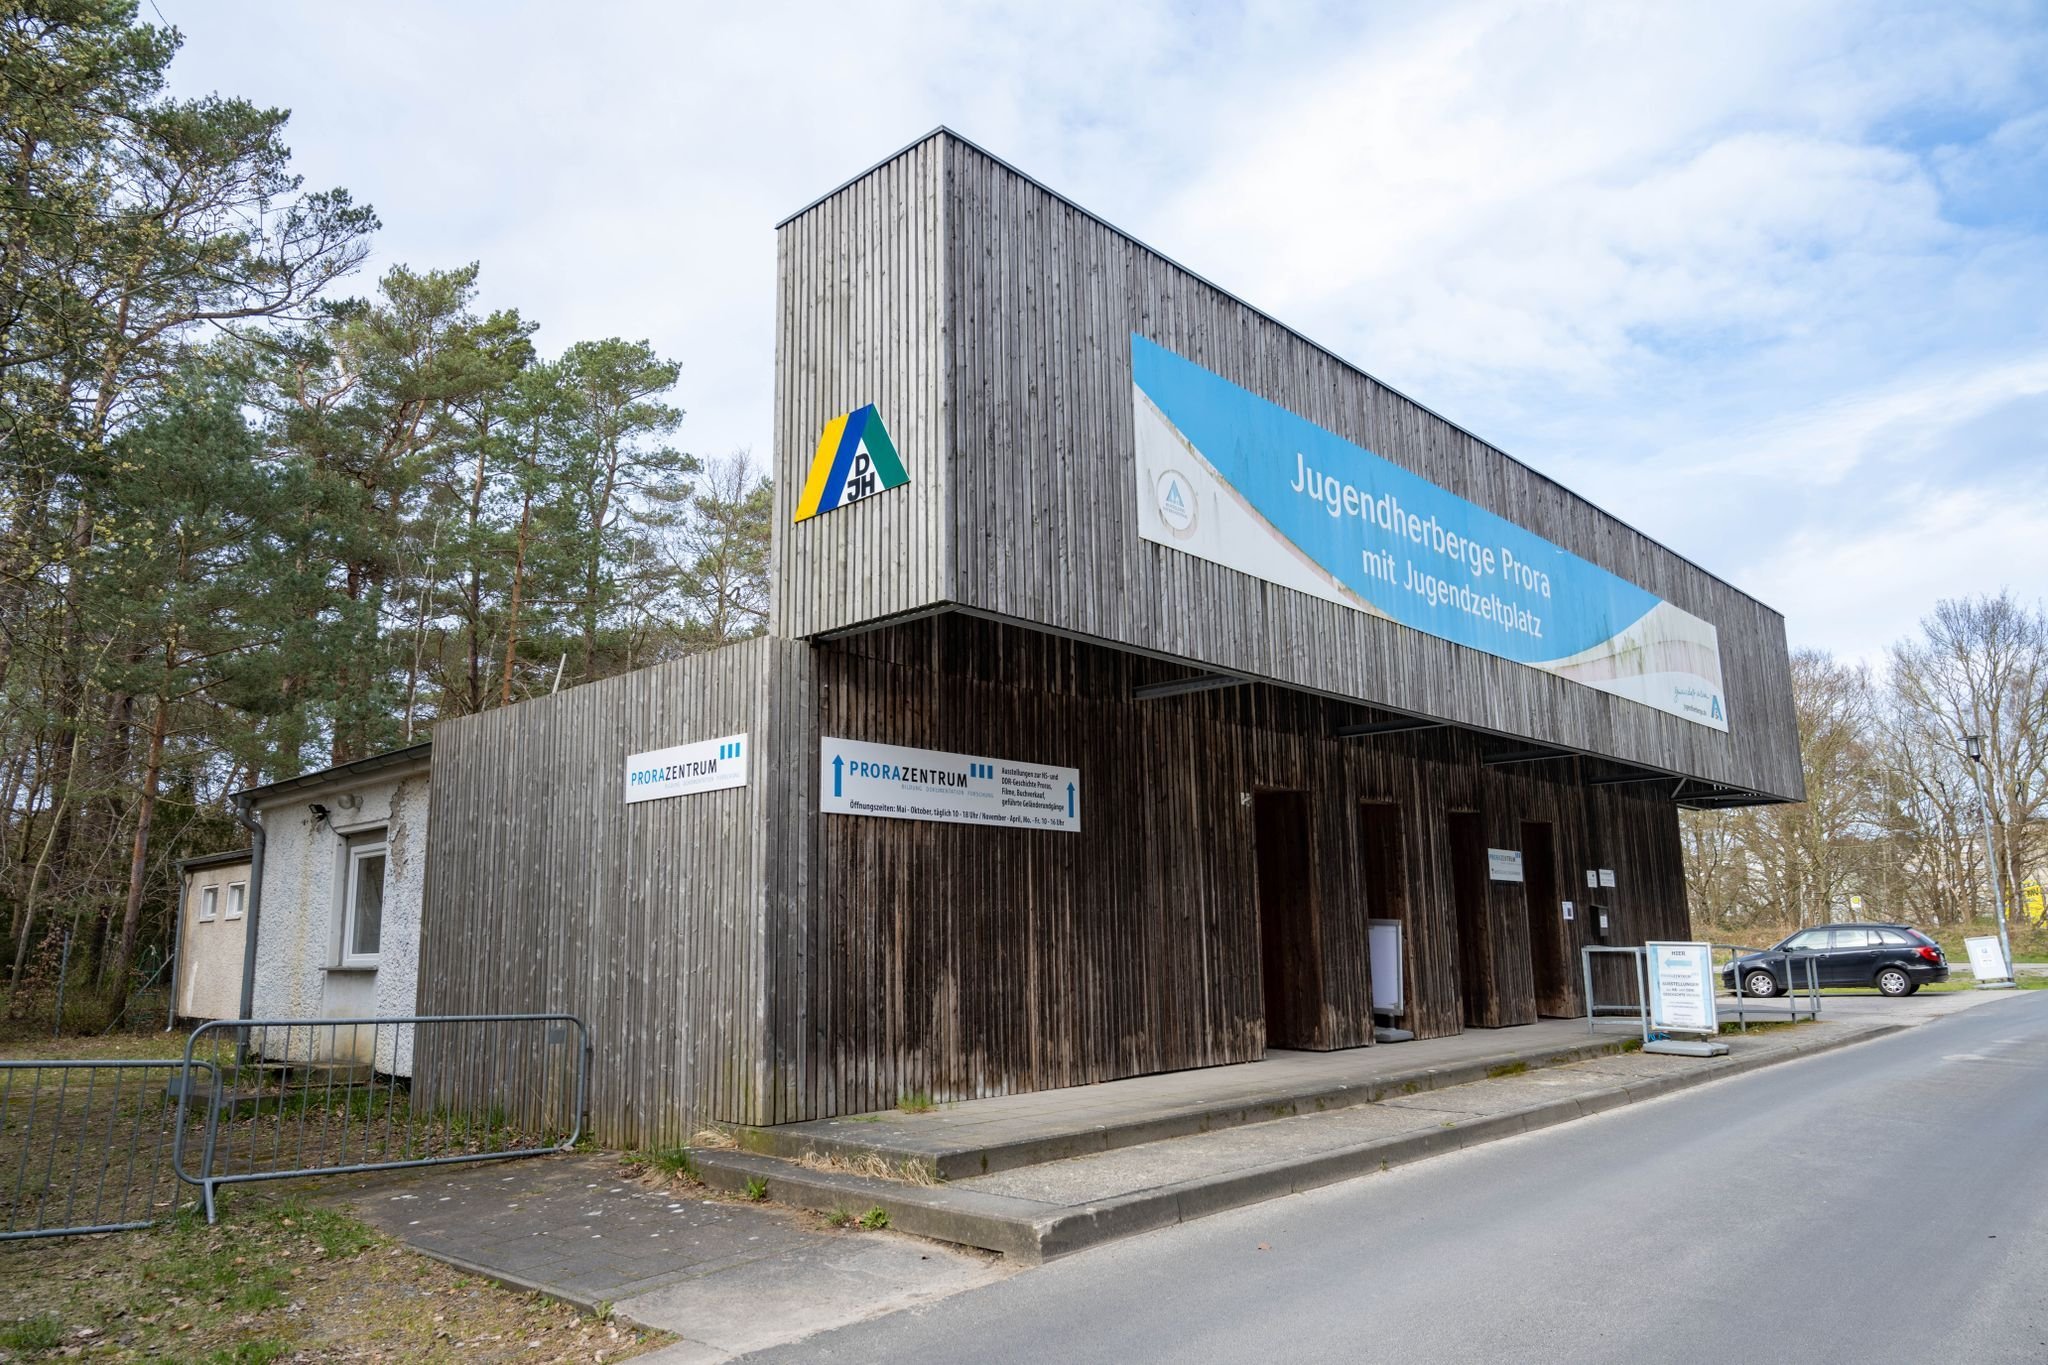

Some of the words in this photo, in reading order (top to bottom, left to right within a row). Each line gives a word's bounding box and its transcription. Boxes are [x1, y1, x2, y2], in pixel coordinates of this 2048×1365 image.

[855, 452, 870, 478] D
[847, 471, 876, 502] JH
[1290, 452, 1496, 577] Jugendherberge
[1501, 547, 1551, 599] Prora
[1362, 548, 1397, 585] mit
[1403, 560, 1543, 639] Jugendzeltplatz
[631, 758, 718, 787] PRORAZENTRUM
[849, 761, 967, 788] PRORAZENTRUM
[1001, 767, 1033, 779] Ausstellungen
[1001, 777, 1036, 788] DDR-Geschichte
[1001, 787, 1016, 796] Filme,
[1001, 798, 1022, 807] geführte
[849, 799, 896, 813] Öffnungszeiten:
[896, 805, 906, 813] Mai
[910, 806, 933, 816] Oktober,
[934, 808, 952, 818] täglich
[952, 809, 959, 817] 10
[969, 811, 978, 819] Uhr
[982, 812, 1006, 821] November
[1056, 818, 1065, 826] Uhr
